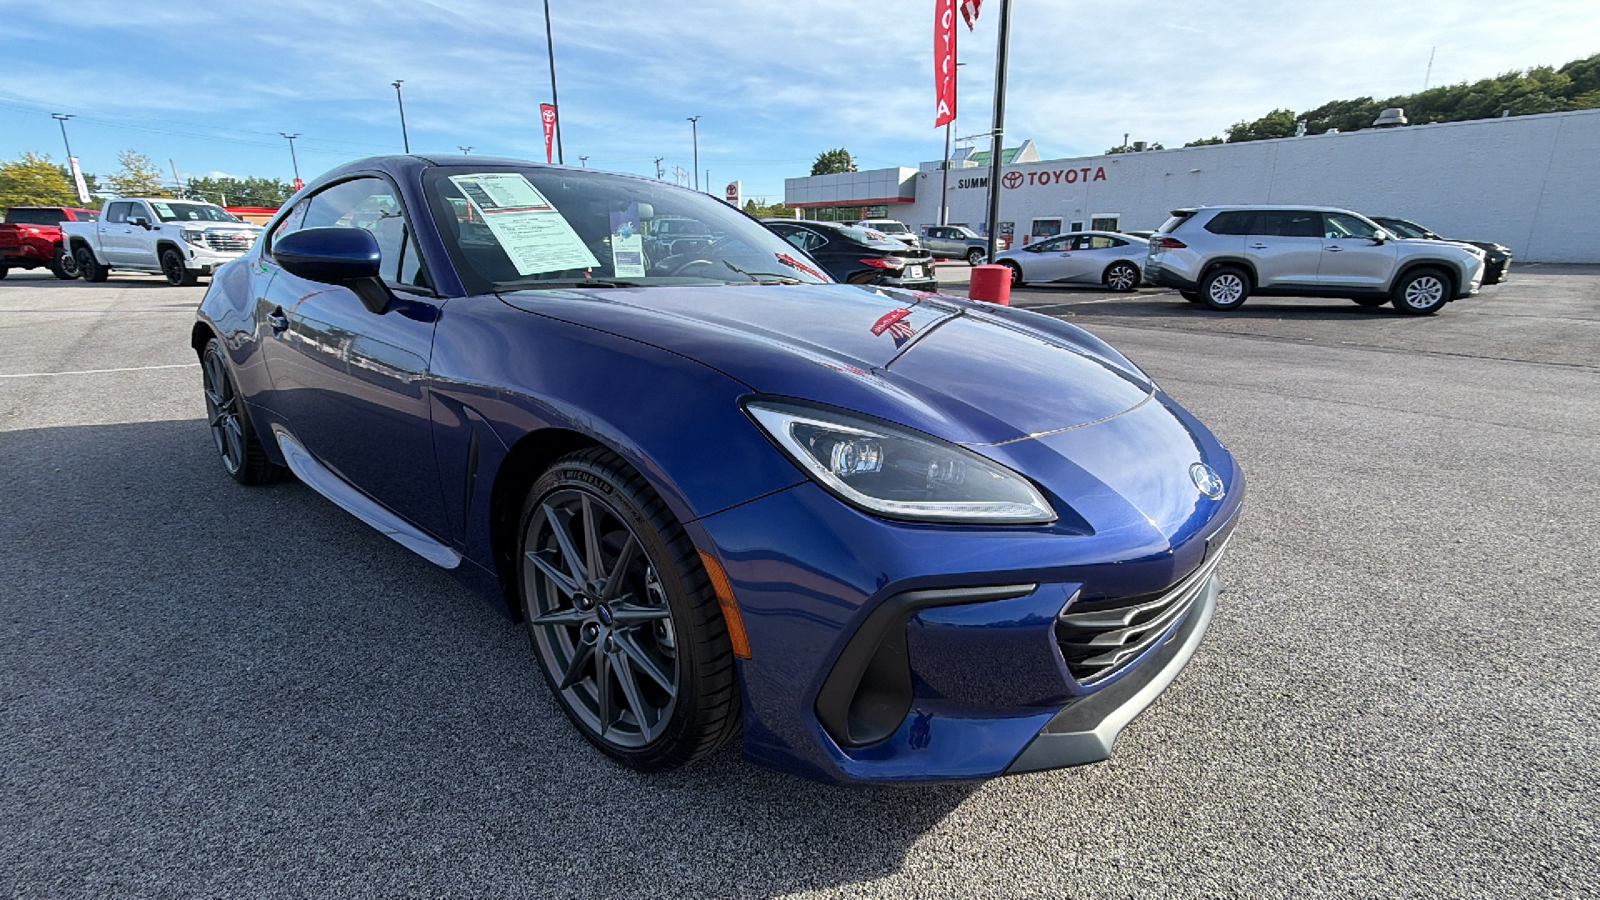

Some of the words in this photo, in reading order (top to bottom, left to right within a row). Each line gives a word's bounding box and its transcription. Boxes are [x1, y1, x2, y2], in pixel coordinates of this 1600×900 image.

[958, 177, 988, 189] SUMM
[1027, 167, 1107, 186] TOYOTA
[566, 470, 611, 493] MICHELIN
